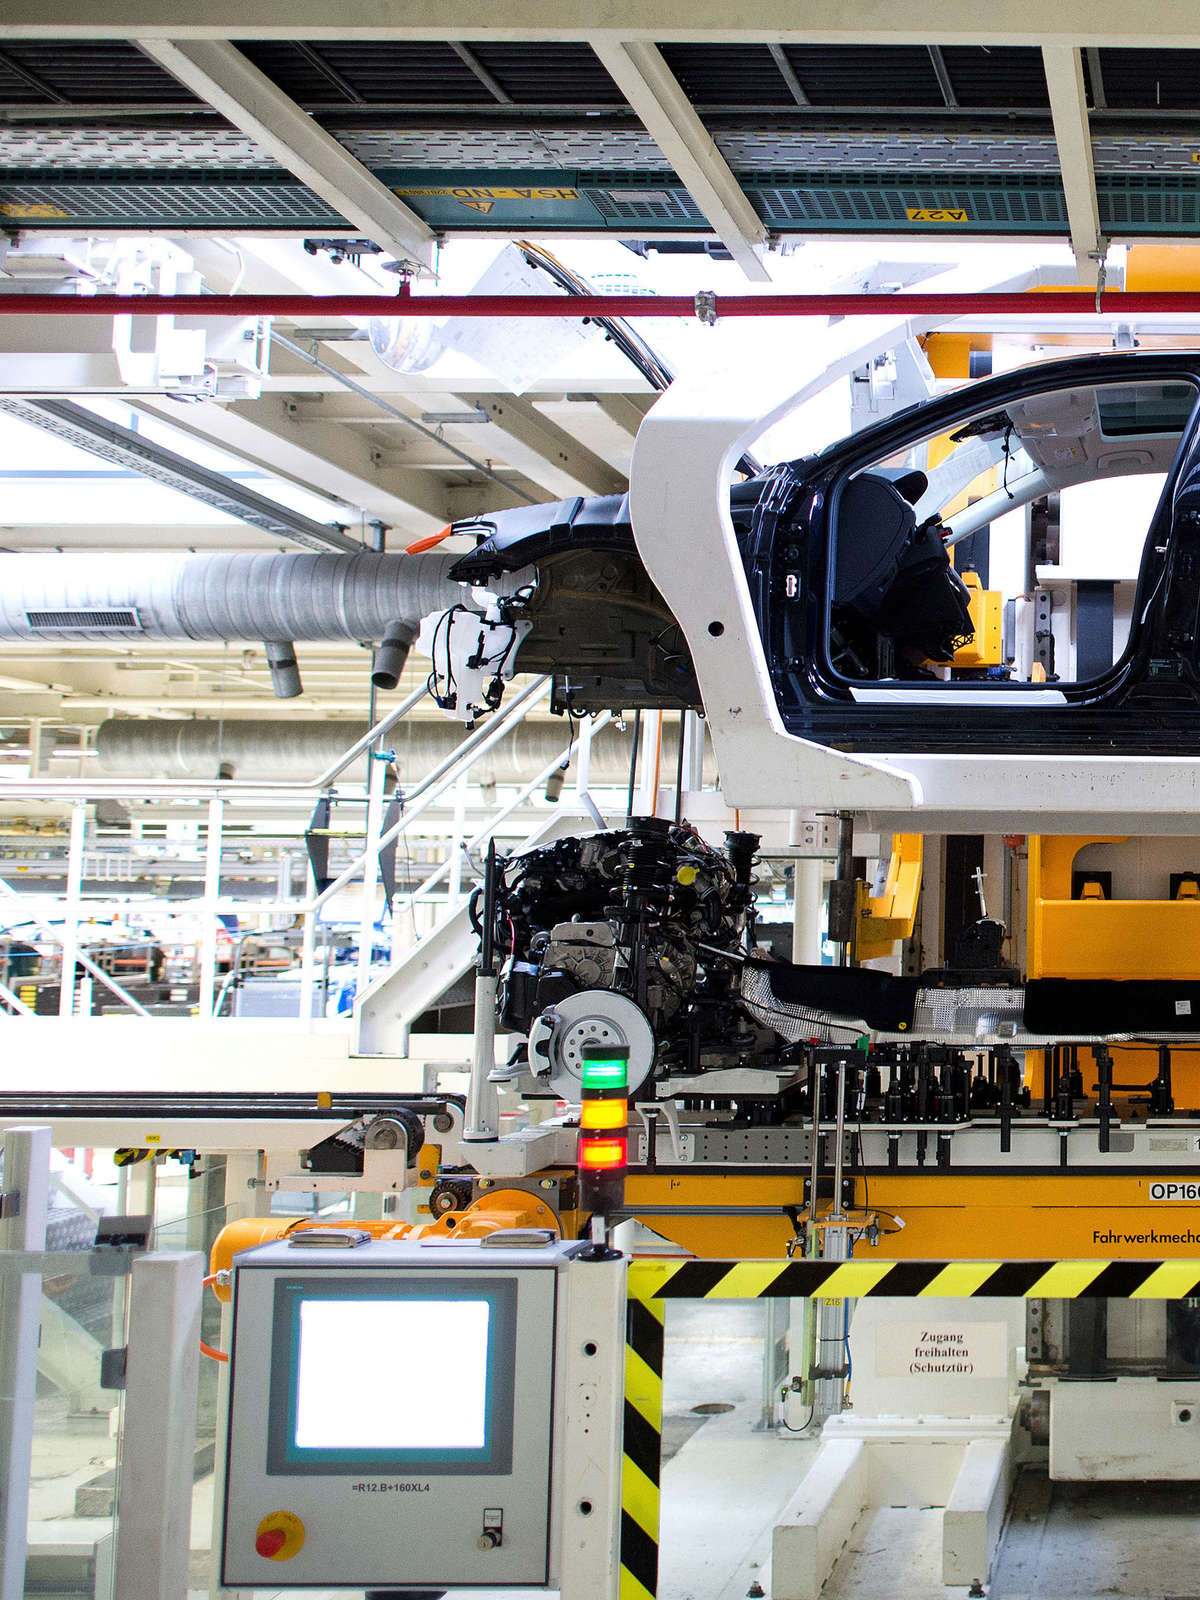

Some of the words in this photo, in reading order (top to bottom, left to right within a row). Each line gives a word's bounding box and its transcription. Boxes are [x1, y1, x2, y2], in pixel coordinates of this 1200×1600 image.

[911, 210, 964, 220] A27
[920, 1331, 964, 1344] Zugang
[914, 1347, 969, 1358] freihalten
[909, 1362, 974, 1375] (Schutztür)
[352, 1483, 431, 1492] =R12.B+160XL4
